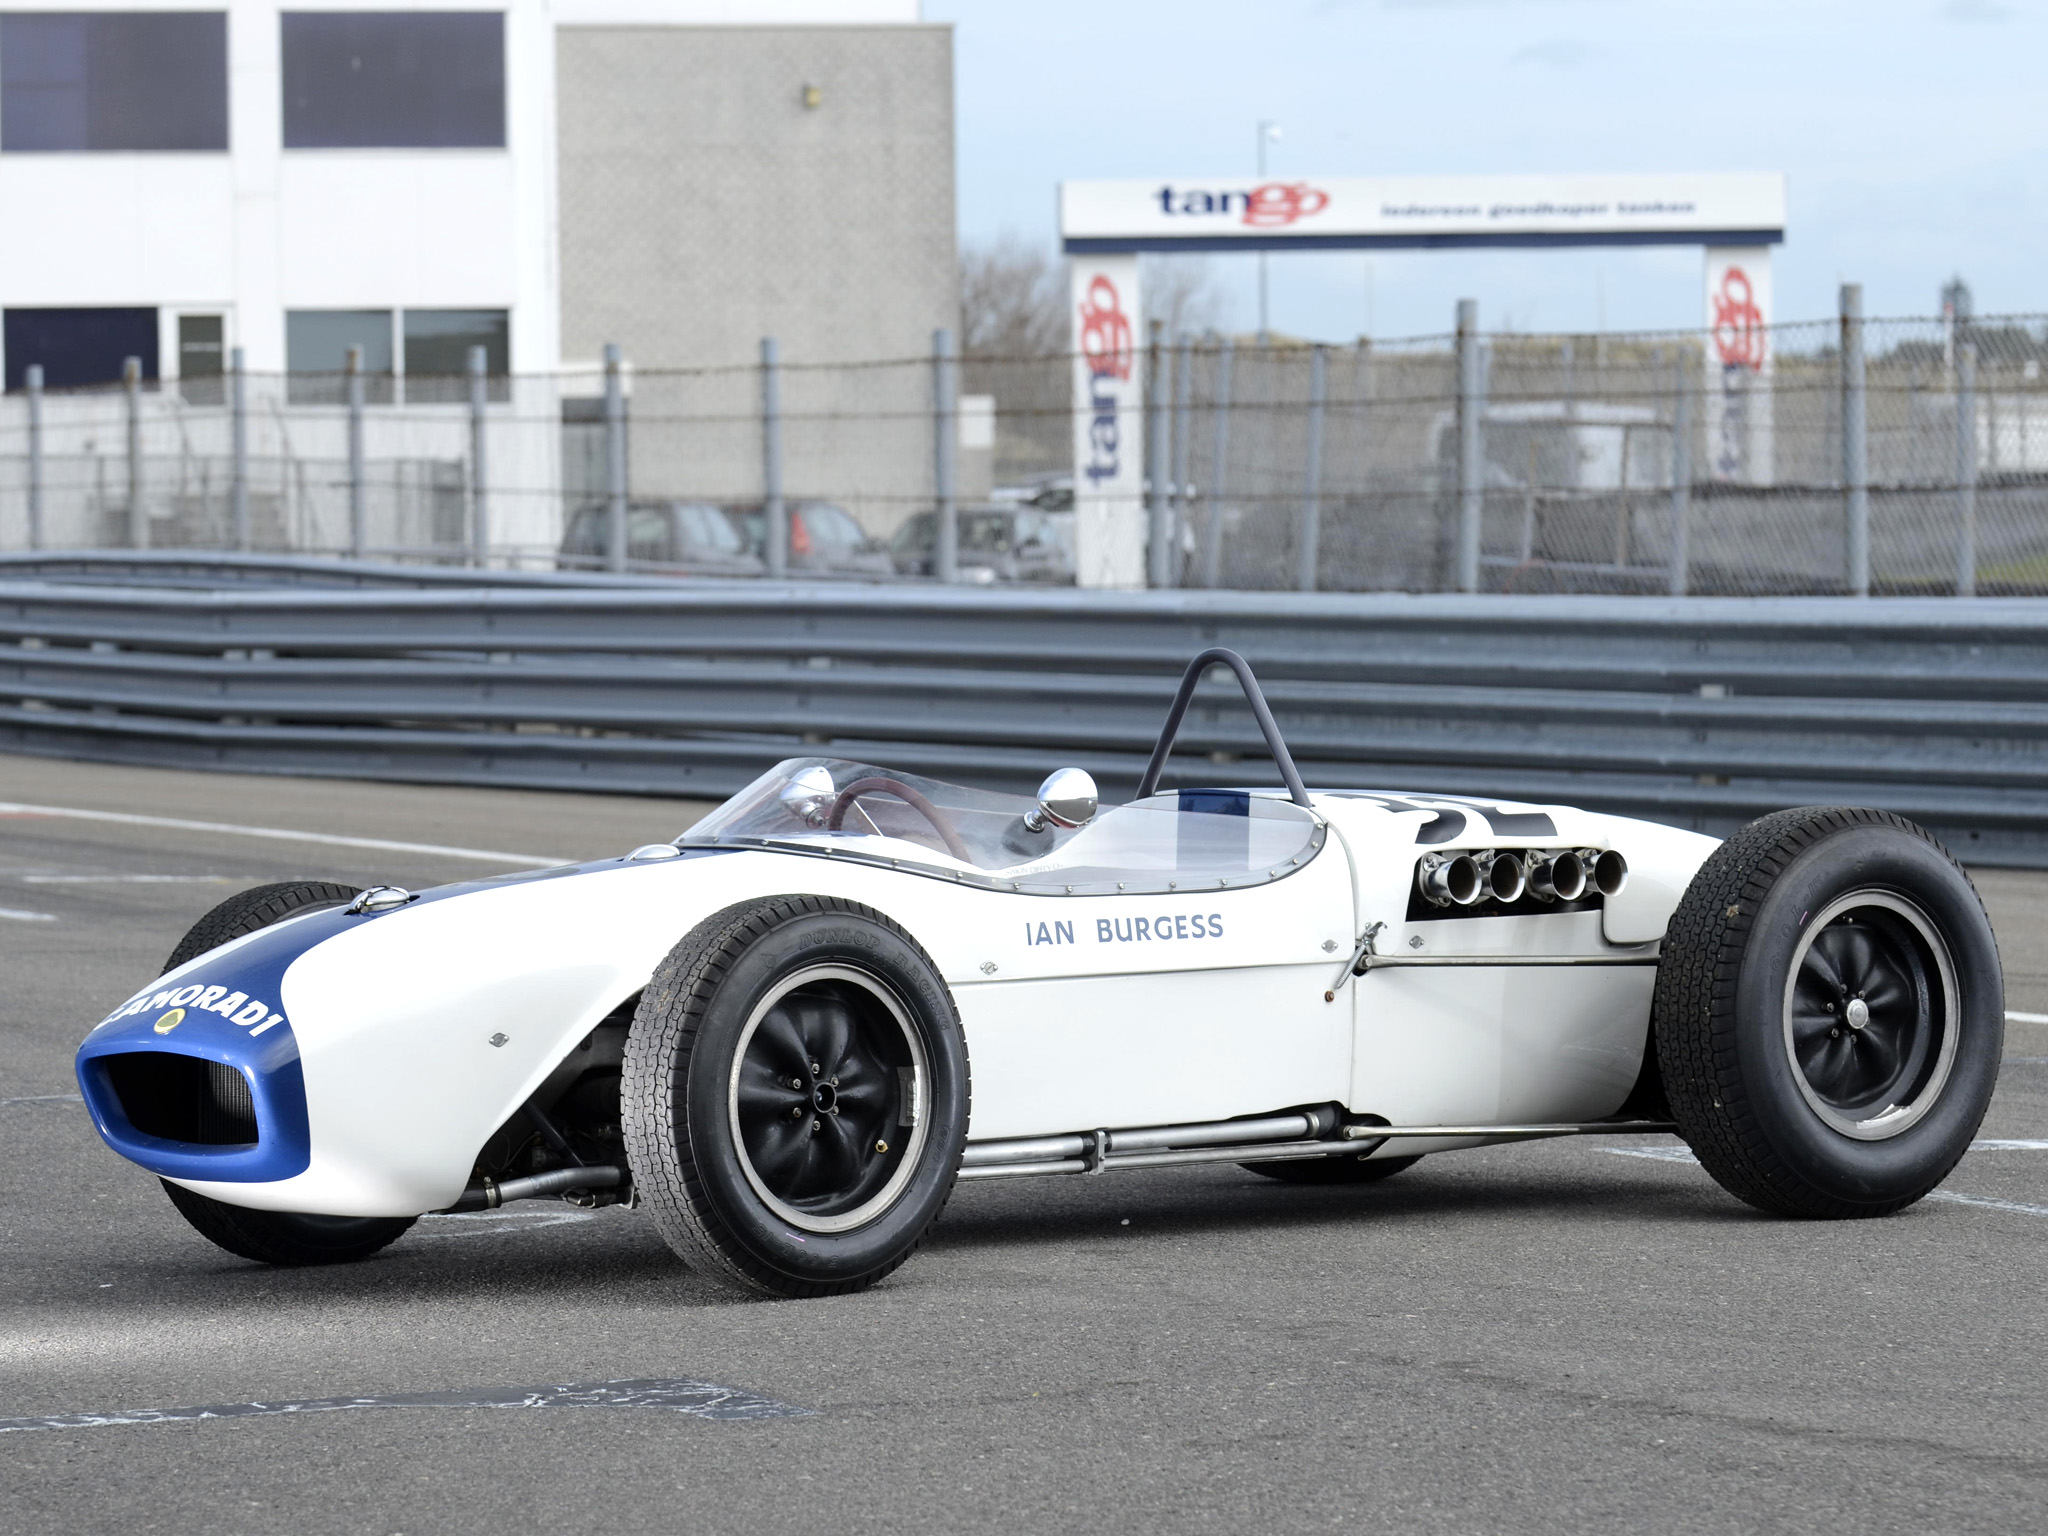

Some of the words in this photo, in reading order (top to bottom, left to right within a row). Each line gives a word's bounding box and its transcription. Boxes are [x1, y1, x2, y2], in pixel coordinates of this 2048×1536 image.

[1156, 182, 1330, 227] tango
[1080, 273, 1132, 487] tango
[1026, 920, 1075, 946] IAN
[1096, 913, 1224, 943] BURGESS
[799, 927, 881, 950] DUNLOP
[893, 952, 951, 1031] RACING
